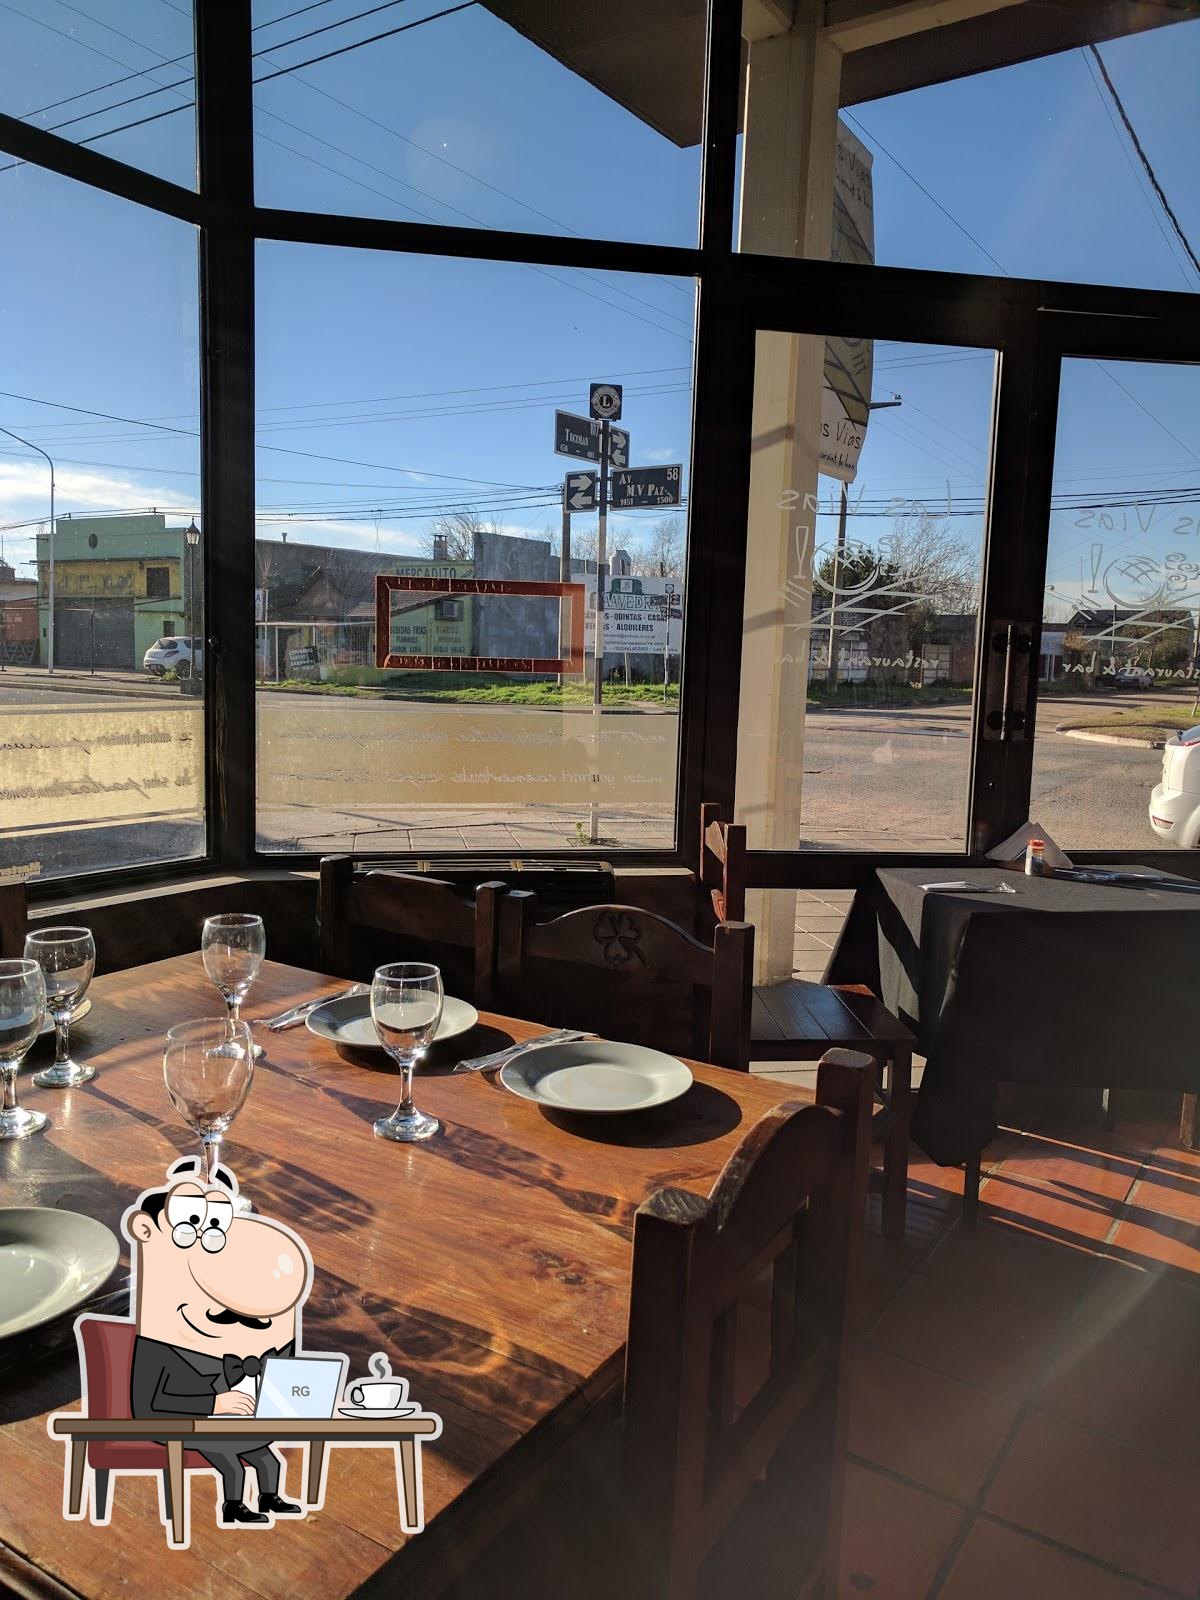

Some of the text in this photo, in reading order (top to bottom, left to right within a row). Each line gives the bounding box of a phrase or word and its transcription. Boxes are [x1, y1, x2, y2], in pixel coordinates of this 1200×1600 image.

[666, 468, 679, 481] 58
[656, 496, 673, 504] 1500
[614, 613, 642, 621] QUINTAS
[616, 624, 654, 632] ALQUILERES
